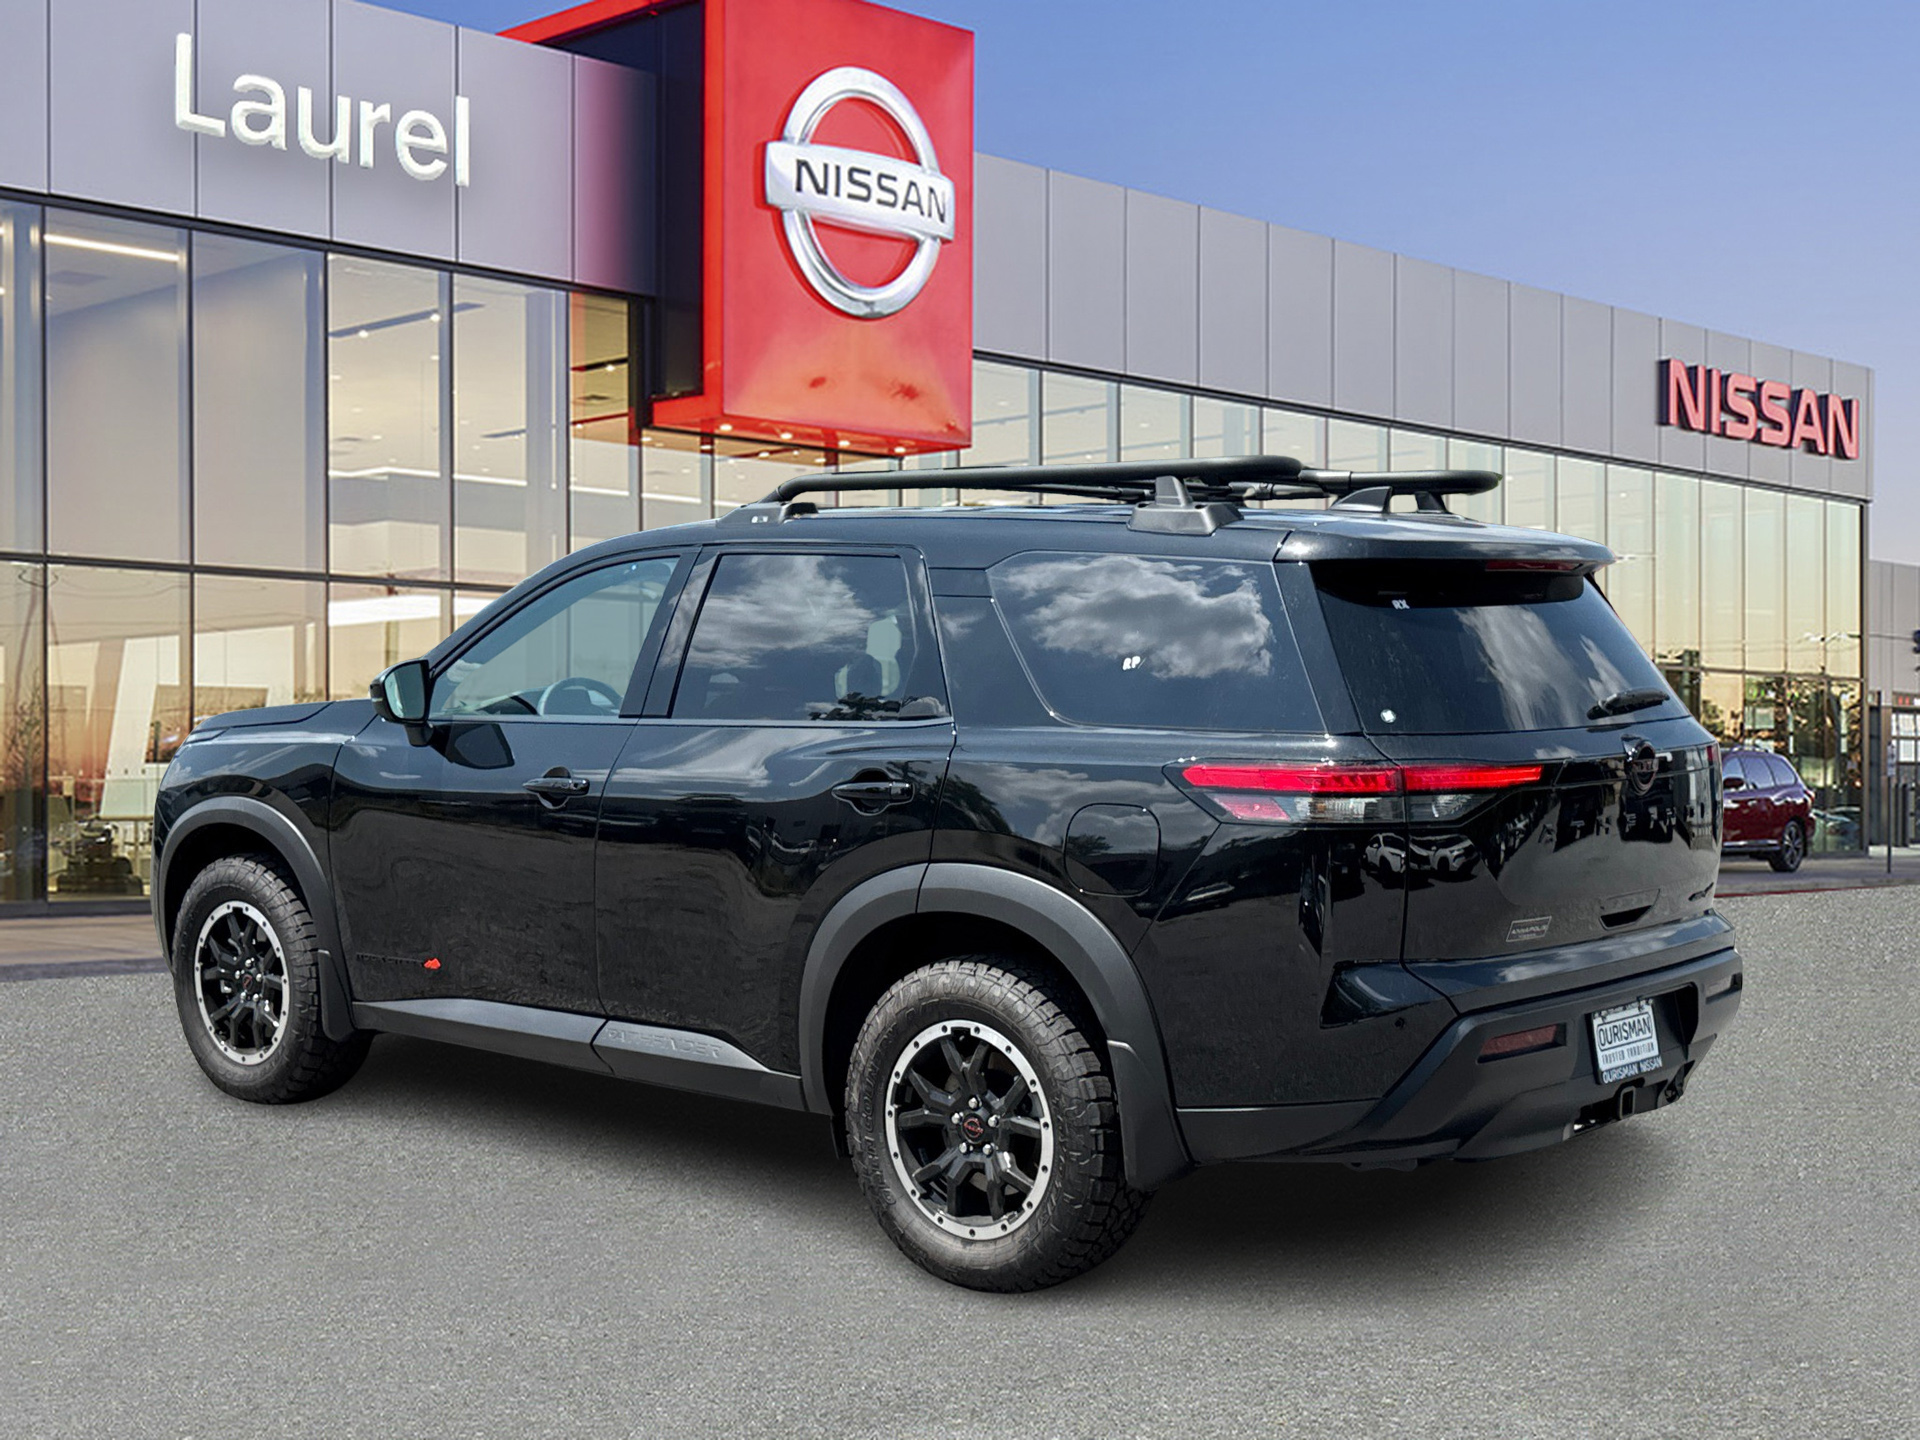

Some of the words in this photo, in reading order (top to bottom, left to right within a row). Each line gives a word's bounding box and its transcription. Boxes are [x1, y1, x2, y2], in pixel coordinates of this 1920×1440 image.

[174, 32, 470, 188] Laurel
[794, 157, 948, 225] NISSAN
[1660, 358, 1860, 459] NISSAN
[1598, 1017, 1651, 1047] OURISMAN
[1603, 1063, 1639, 1084] OURISMAN
[1639, 1057, 1663, 1073] NISSAN
